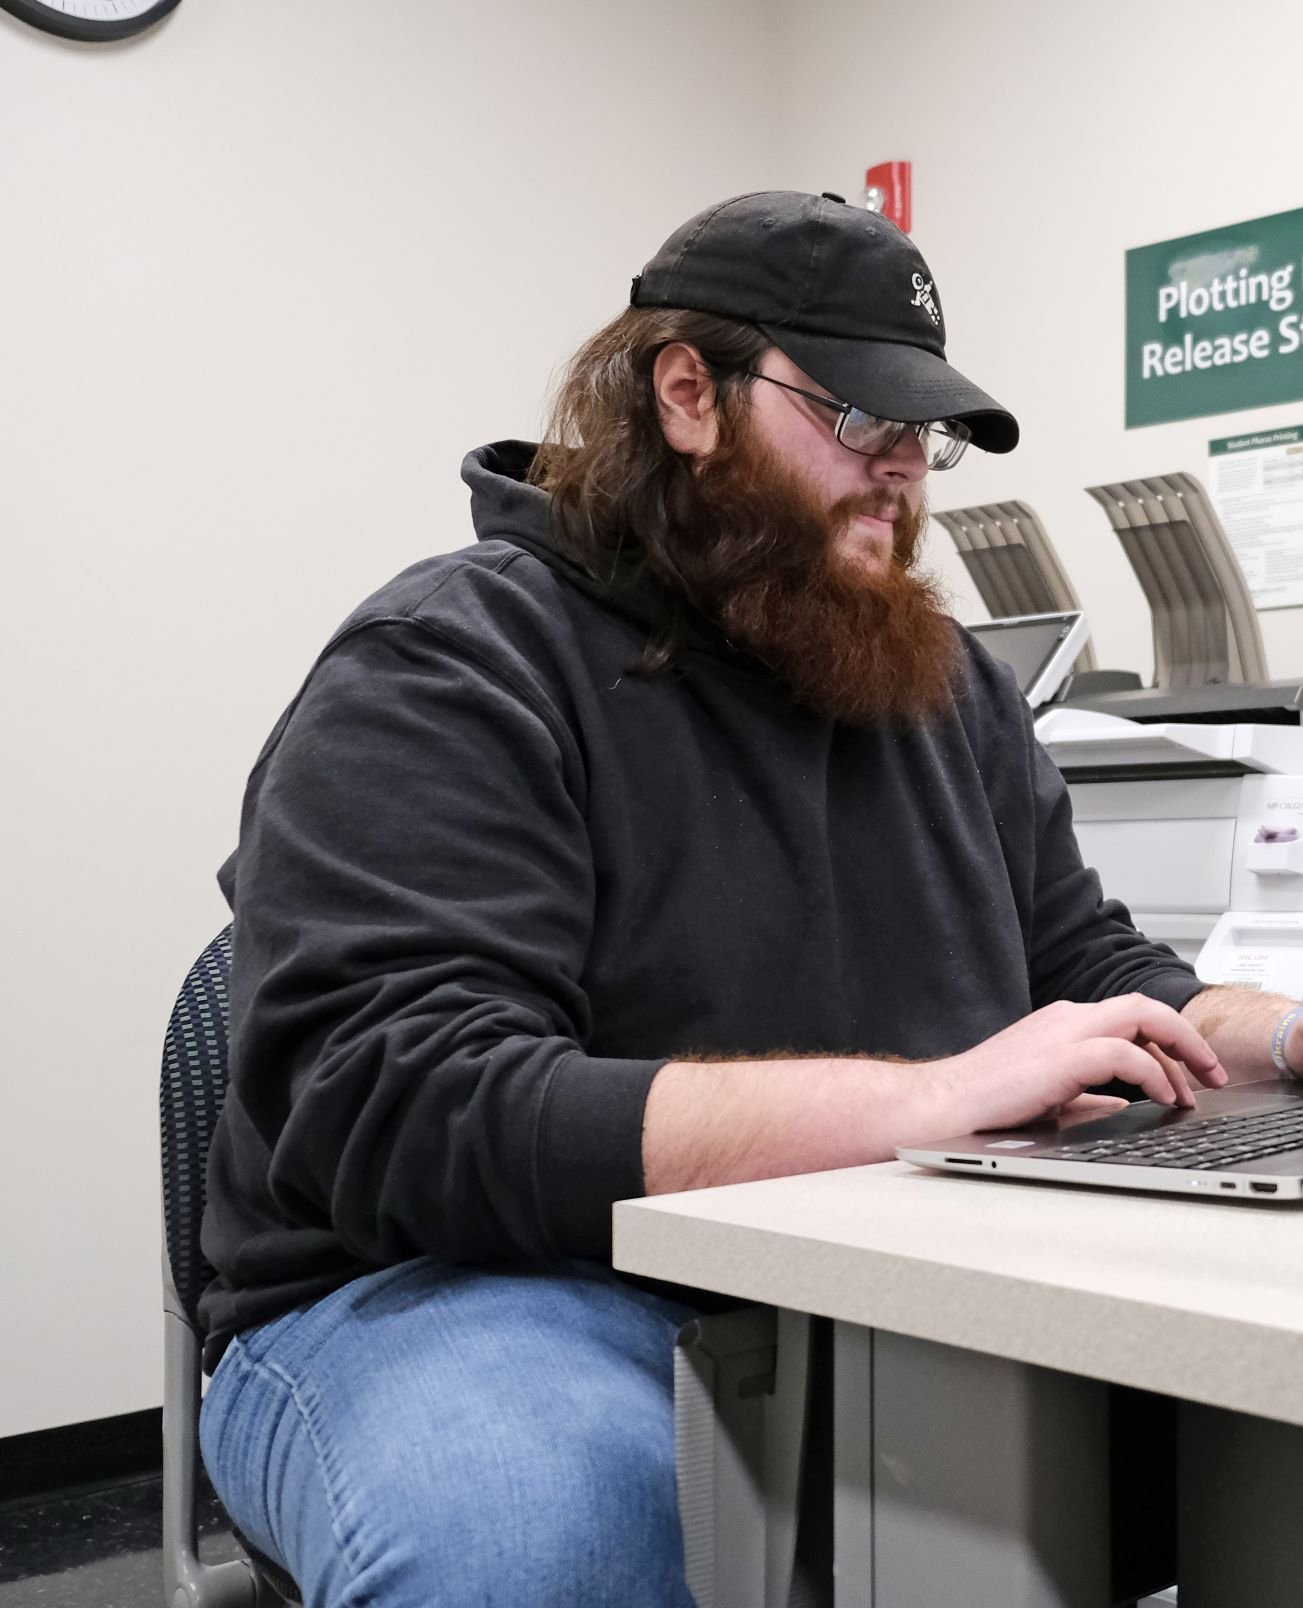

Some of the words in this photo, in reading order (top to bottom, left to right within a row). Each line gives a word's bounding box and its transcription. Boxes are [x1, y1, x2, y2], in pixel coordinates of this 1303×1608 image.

[1158, 263, 1295, 323] Plotting
[1142, 328, 1271, 379] Release
[1226, 439, 1250, 449] Student
[1273, 431, 1298, 441] Printing
